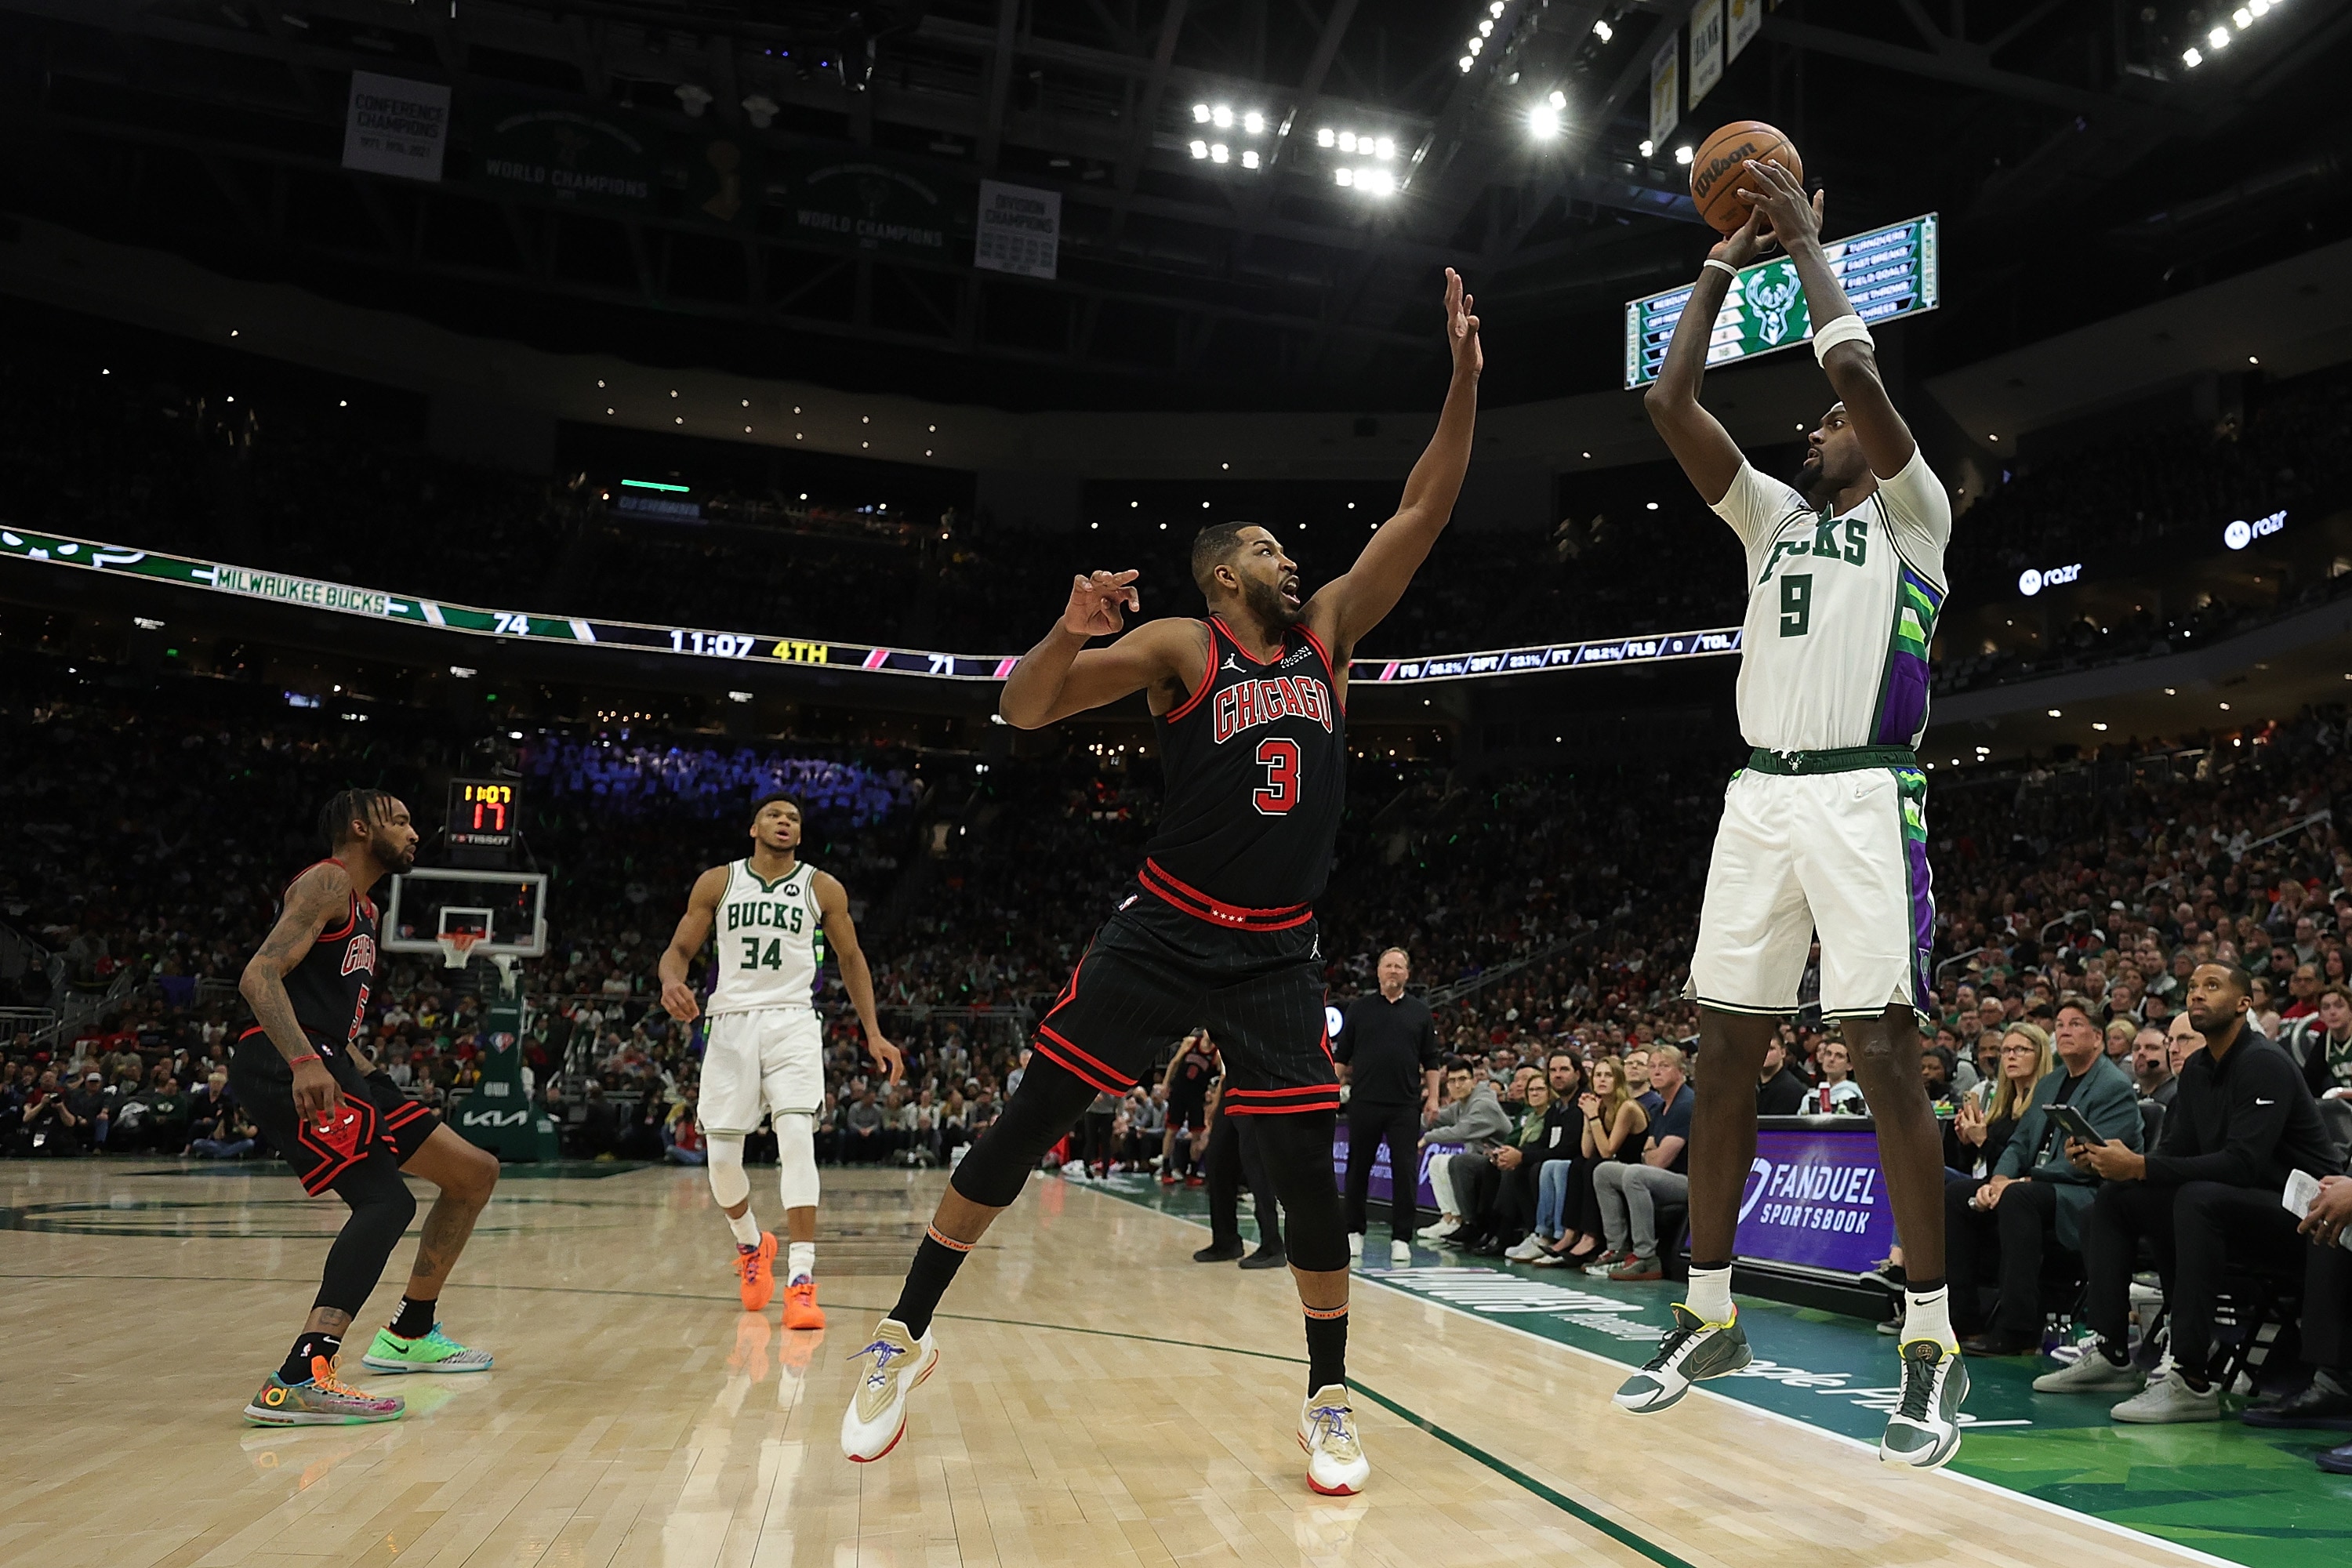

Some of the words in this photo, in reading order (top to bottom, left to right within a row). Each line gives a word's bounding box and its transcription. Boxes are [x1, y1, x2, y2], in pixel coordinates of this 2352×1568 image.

[355, 94, 445, 121] CONFERENCE
[358, 111, 440, 138] CHAMPIONS
[486, 158, 546, 183] WORLD
[551, 169, 648, 198] CHAMPIONS
[1693, 140, 1757, 199] Wilson
[797, 209, 851, 233] WORLD
[855, 219, 942, 247] CHAMPIONS
[1849, 230, 1907, 252] TURNOVERS
[1847, 257, 1871, 271] FAST
[1871, 246, 1908, 265] BREAKS
[1848, 273, 1875, 288] FIELD
[1875, 263, 1909, 281] GOALS
[1870, 281, 1910, 299] THROWS
[2252, 510, 2288, 539] razr
[2043, 563, 2082, 586] razr
[217, 569, 321, 605] MILWAUKEE
[325, 587, 387, 615] BUCKS
[1780, 573, 1813, 637] 9
[493, 612, 530, 636] 74
[670, 630, 755, 659] 11:07
[771, 641, 828, 666] 4TH
[1399, 665, 1419, 678] FG
[1470, 656, 1500, 672] 3PT
[1552, 649, 1572, 664] FT
[1628, 641, 1657, 657] FLS
[1701, 635, 1732, 651] TOL
[927, 654, 956, 677] 71
[1214, 676, 1333, 745] CHICAGO
[1253, 738, 1301, 815] 3
[464, 786, 511, 804] 11:07
[473, 803, 506, 831] 17
[728, 902, 804, 935] BUCKS
[740, 937, 782, 971] 34
[347, 982, 371, 1043] 5
[1768, 1163, 1876, 1205] FANDUEL
[1759, 1203, 1871, 1235] SPORTSBOOK
